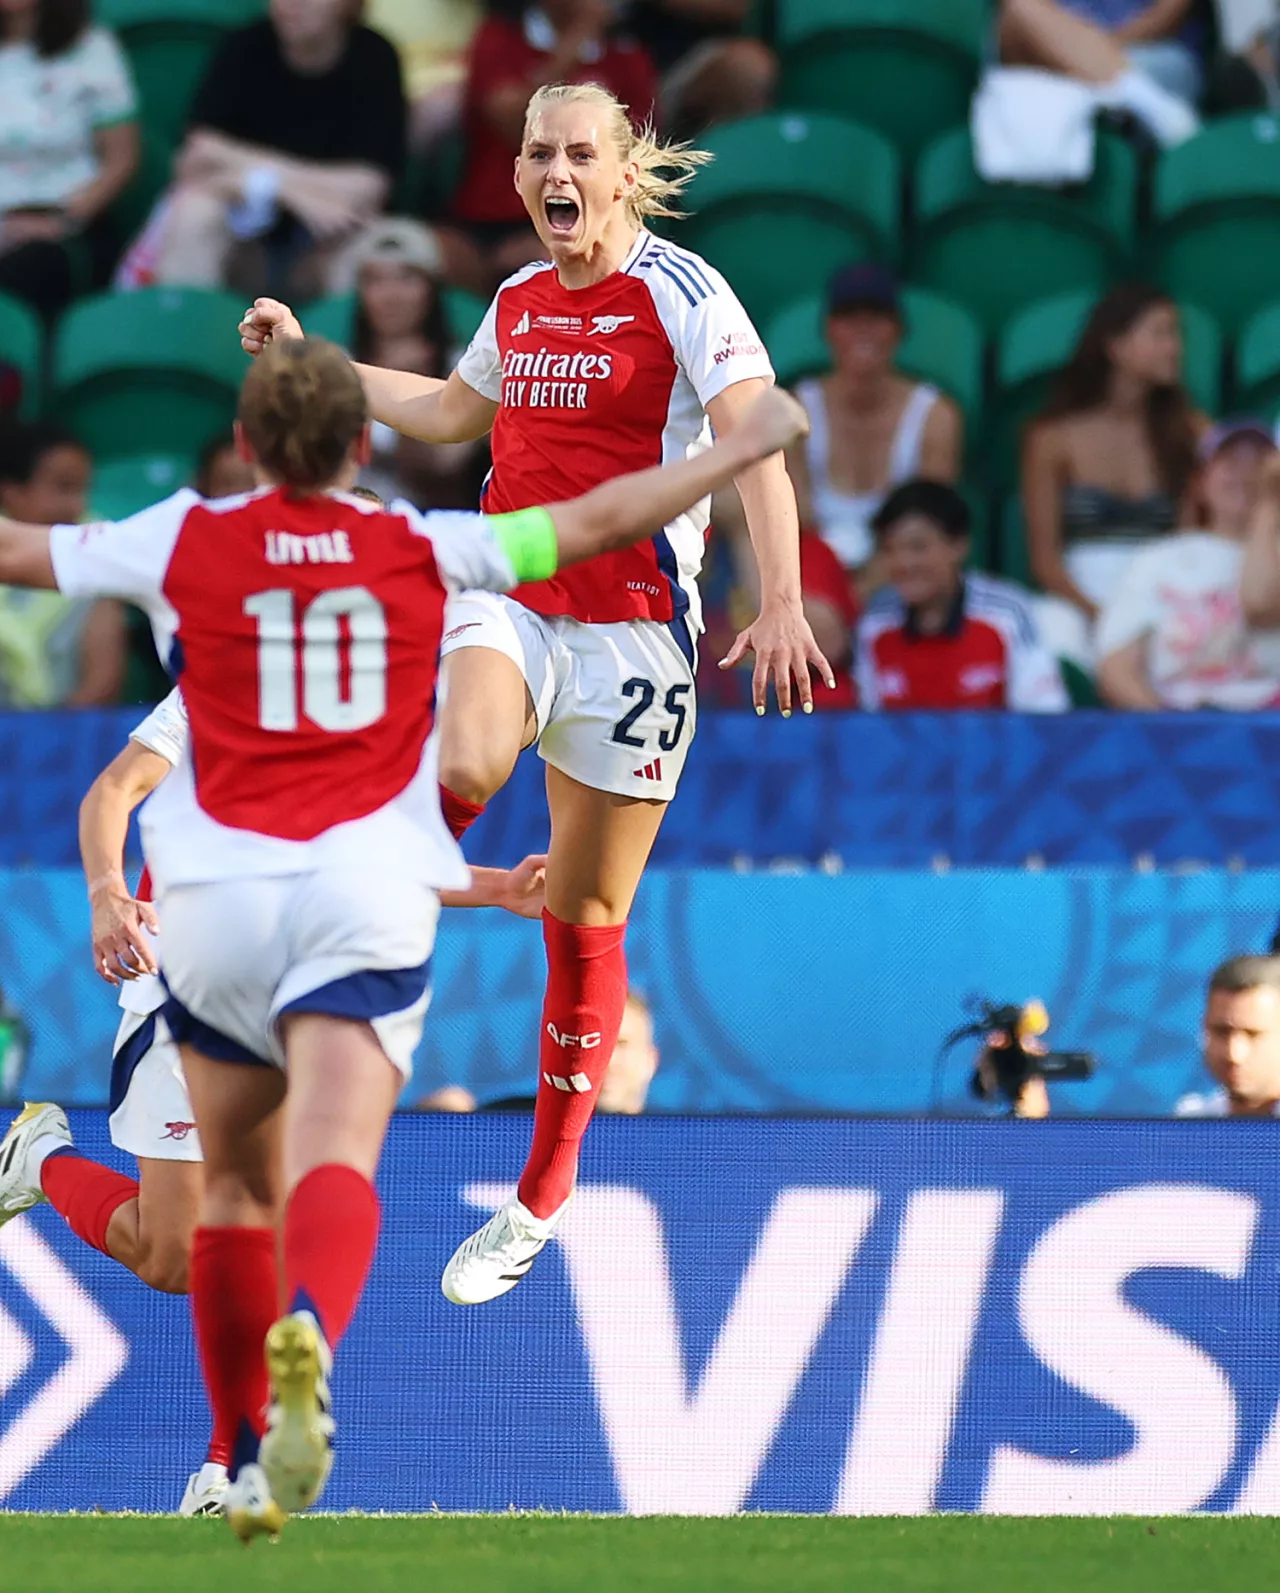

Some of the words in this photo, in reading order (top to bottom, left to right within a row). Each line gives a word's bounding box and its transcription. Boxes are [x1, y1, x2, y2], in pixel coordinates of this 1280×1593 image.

[502, 347, 612, 379] Emirates
[504, 381, 526, 408] FLY
[529, 381, 588, 409] BETTER
[265, 529, 355, 564] LITTLE
[243, 585, 388, 733] 10
[612, 677, 691, 751] 25
[462, 1183, 1280, 1515] VIS
